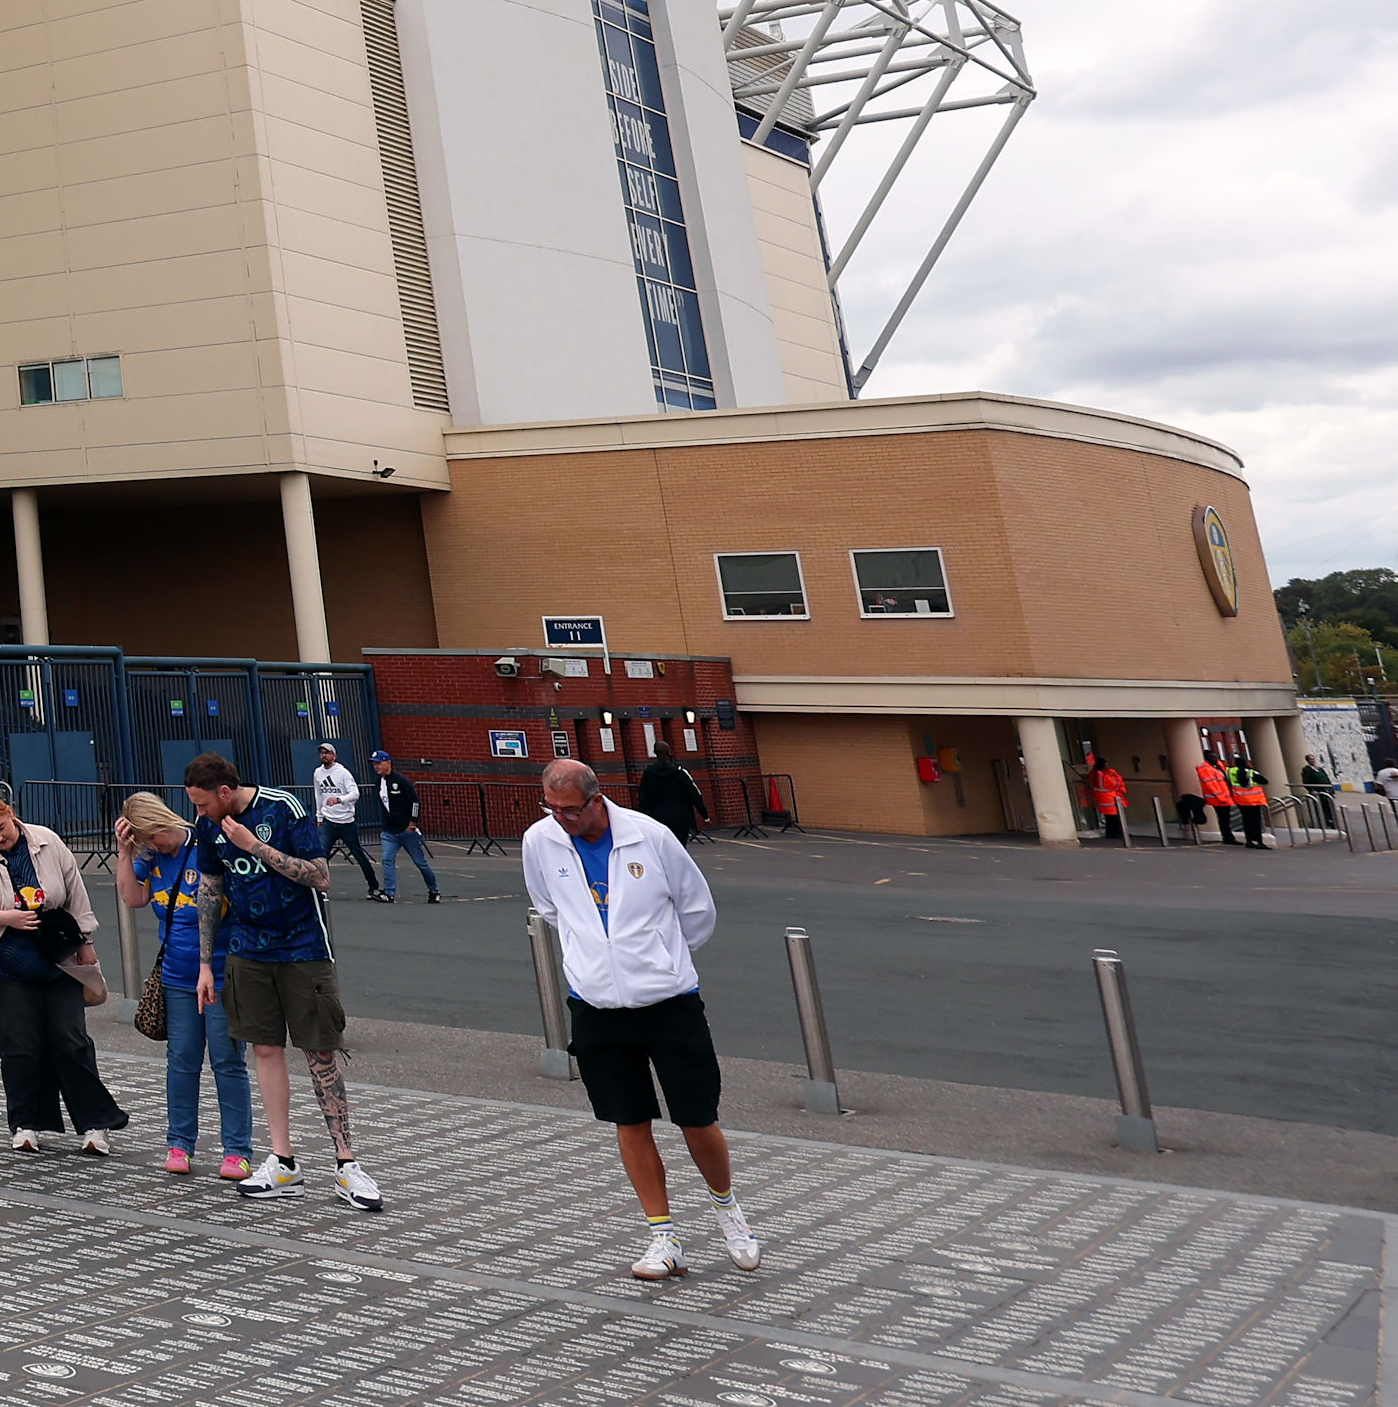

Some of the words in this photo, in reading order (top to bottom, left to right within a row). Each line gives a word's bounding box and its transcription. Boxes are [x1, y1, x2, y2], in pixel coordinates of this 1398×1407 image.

[611, 111, 656, 159] BEFORE
[627, 166, 660, 211] SELF
[631, 221, 671, 267] EVERY
[554, 622, 593, 630] ENTRANCE
[569, 631, 581, 641] 11
[321, 786, 342, 794] adidas
